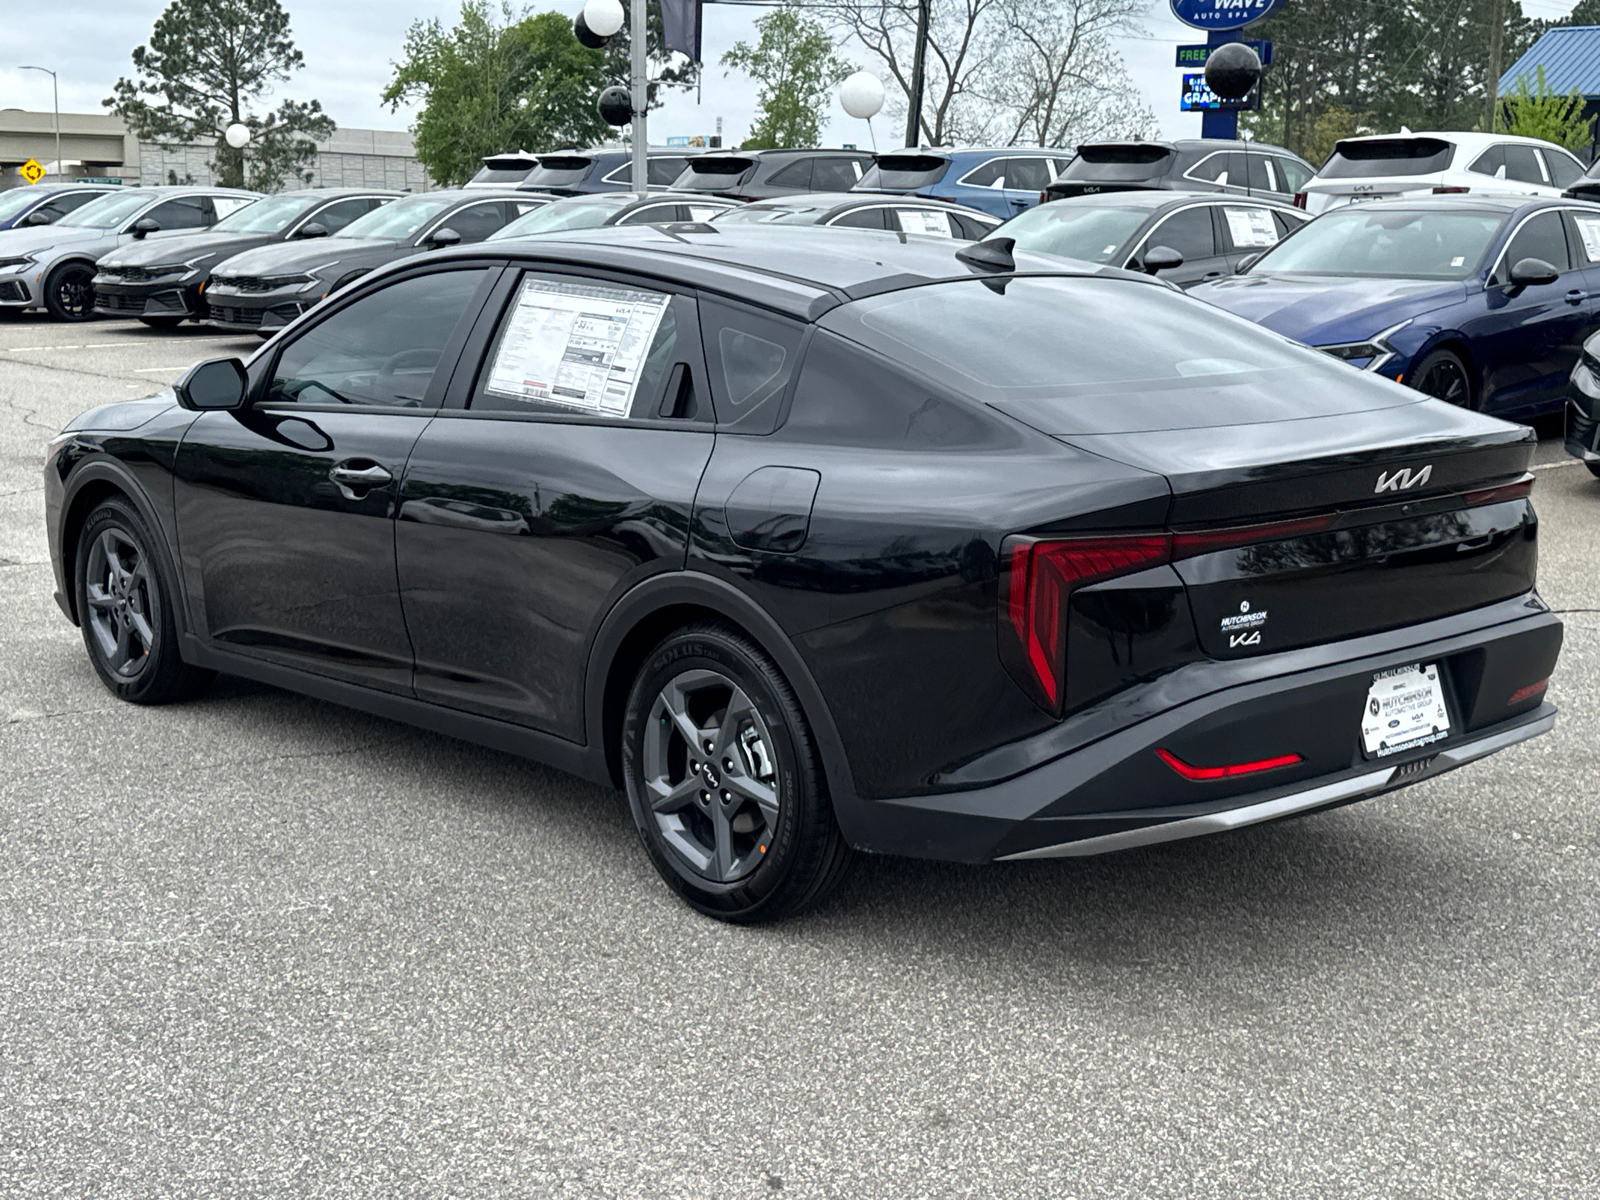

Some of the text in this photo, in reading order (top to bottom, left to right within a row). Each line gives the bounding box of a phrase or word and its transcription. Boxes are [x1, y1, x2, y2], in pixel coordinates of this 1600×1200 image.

[1180, 49, 1206, 61] FREE
[1374, 465, 1433, 494] KIA
[1221, 611, 1268, 627] HUTCHINSON
[653, 643, 704, 671] SOLUS
